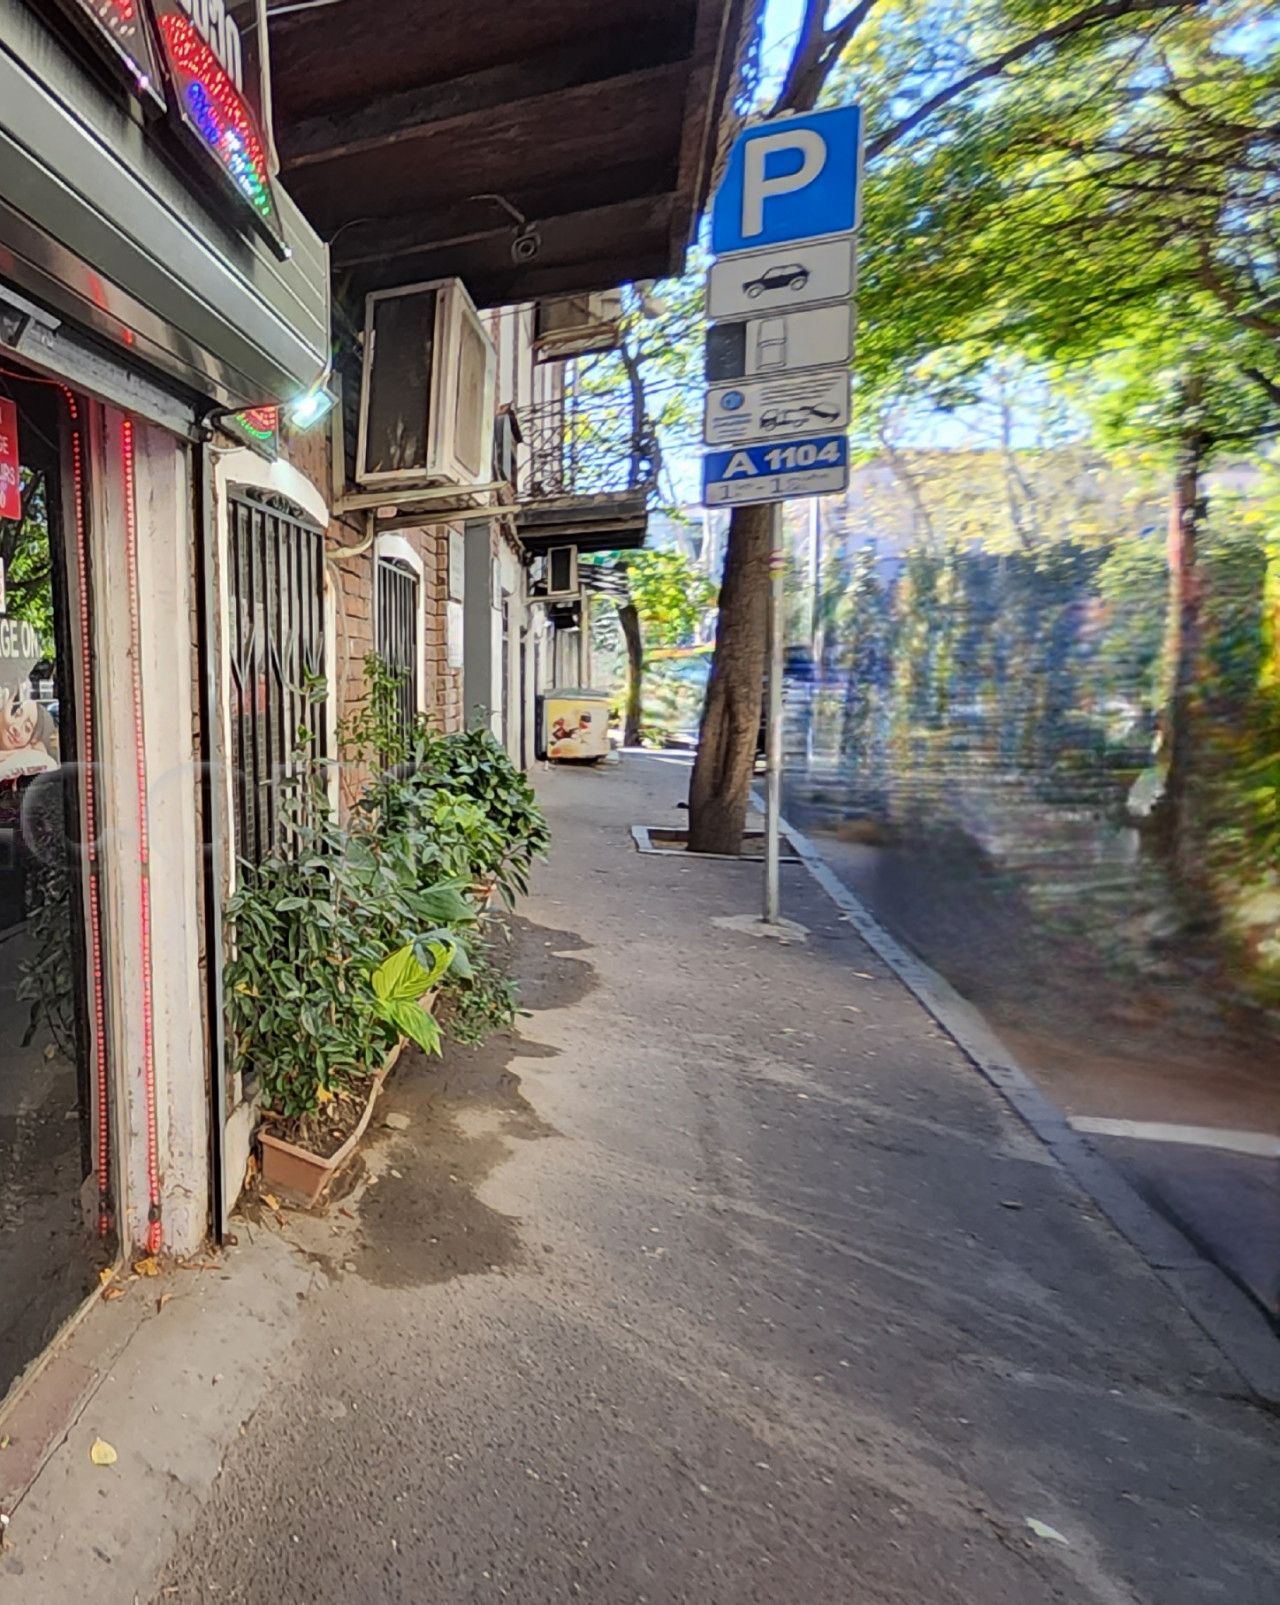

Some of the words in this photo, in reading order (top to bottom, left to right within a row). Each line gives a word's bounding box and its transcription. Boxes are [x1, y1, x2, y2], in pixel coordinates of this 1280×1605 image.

[741, 128, 827, 238] P
[723, 451, 759, 479] A
[763, 440, 841, 470] 1104
